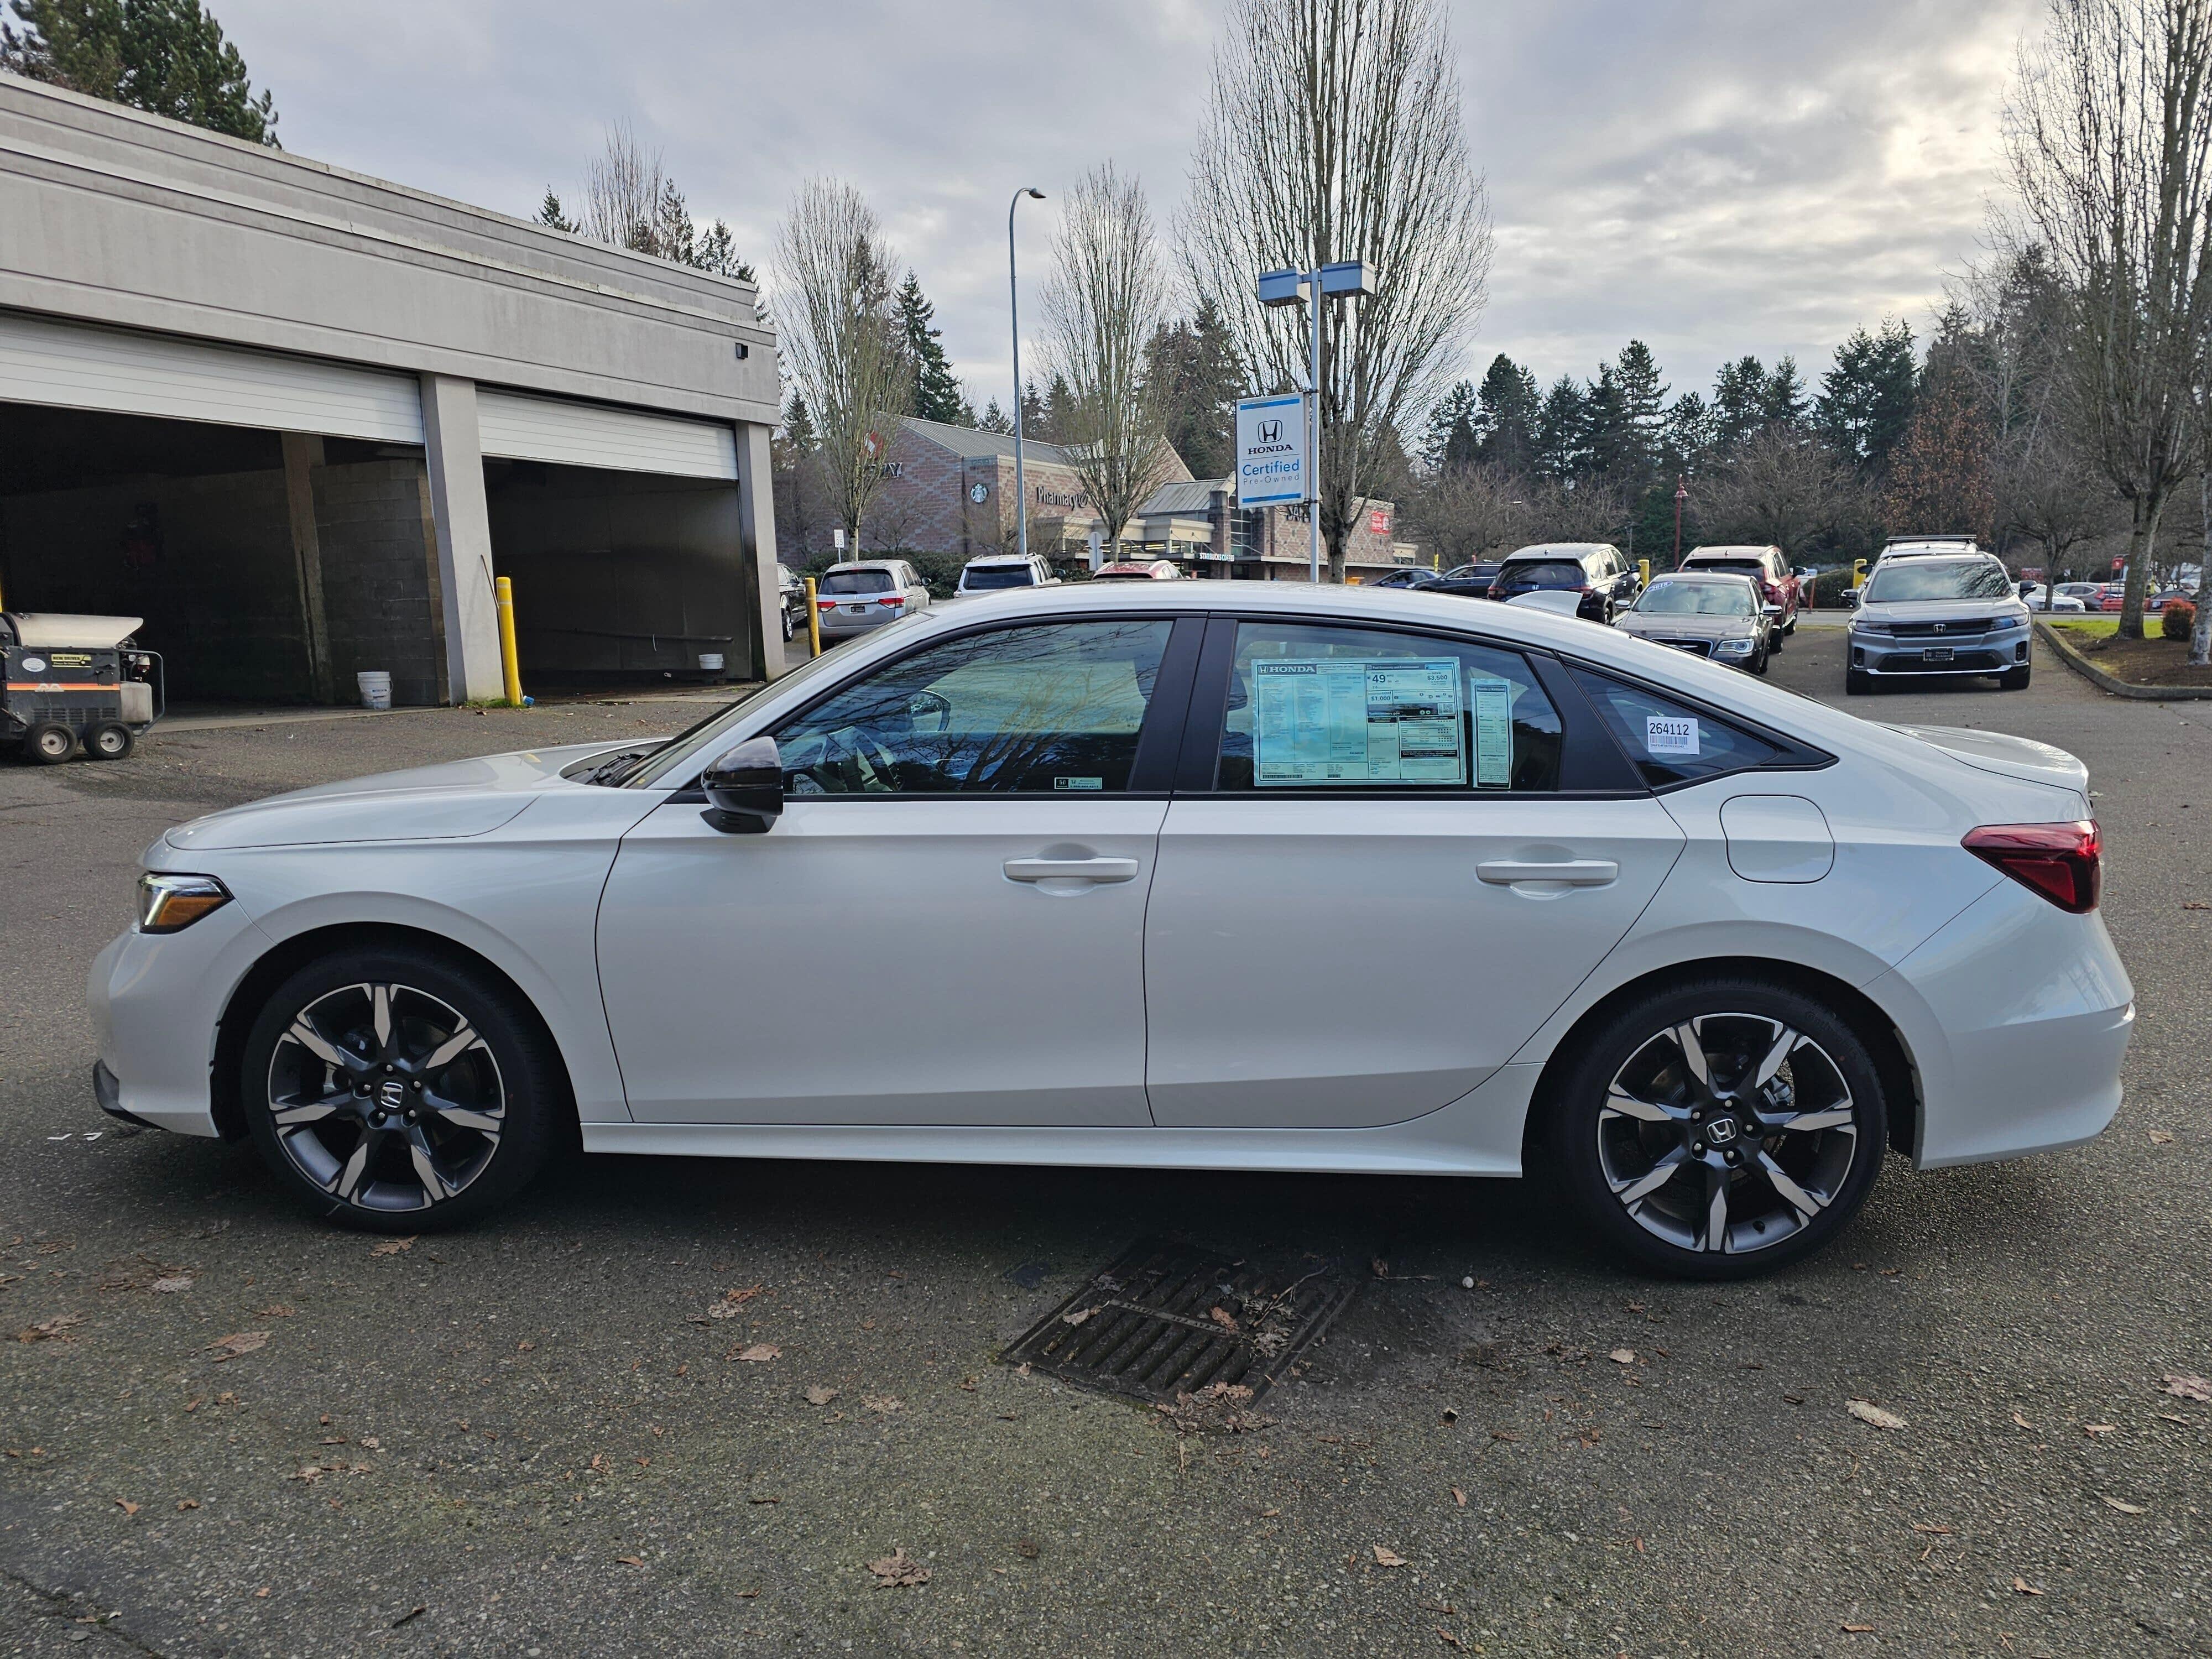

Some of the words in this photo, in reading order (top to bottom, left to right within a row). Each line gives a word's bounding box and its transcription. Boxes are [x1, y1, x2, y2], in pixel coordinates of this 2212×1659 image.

[1248, 444, 1293, 455] HONDA
[1243, 458, 1299, 476] Certified
[1243, 473, 1300, 485] Pre-Owned
[1037, 486, 1078, 511] Pharmacy
[1372, 674, 1385, 683] 49
[1649, 723, 1690, 736] 264112
